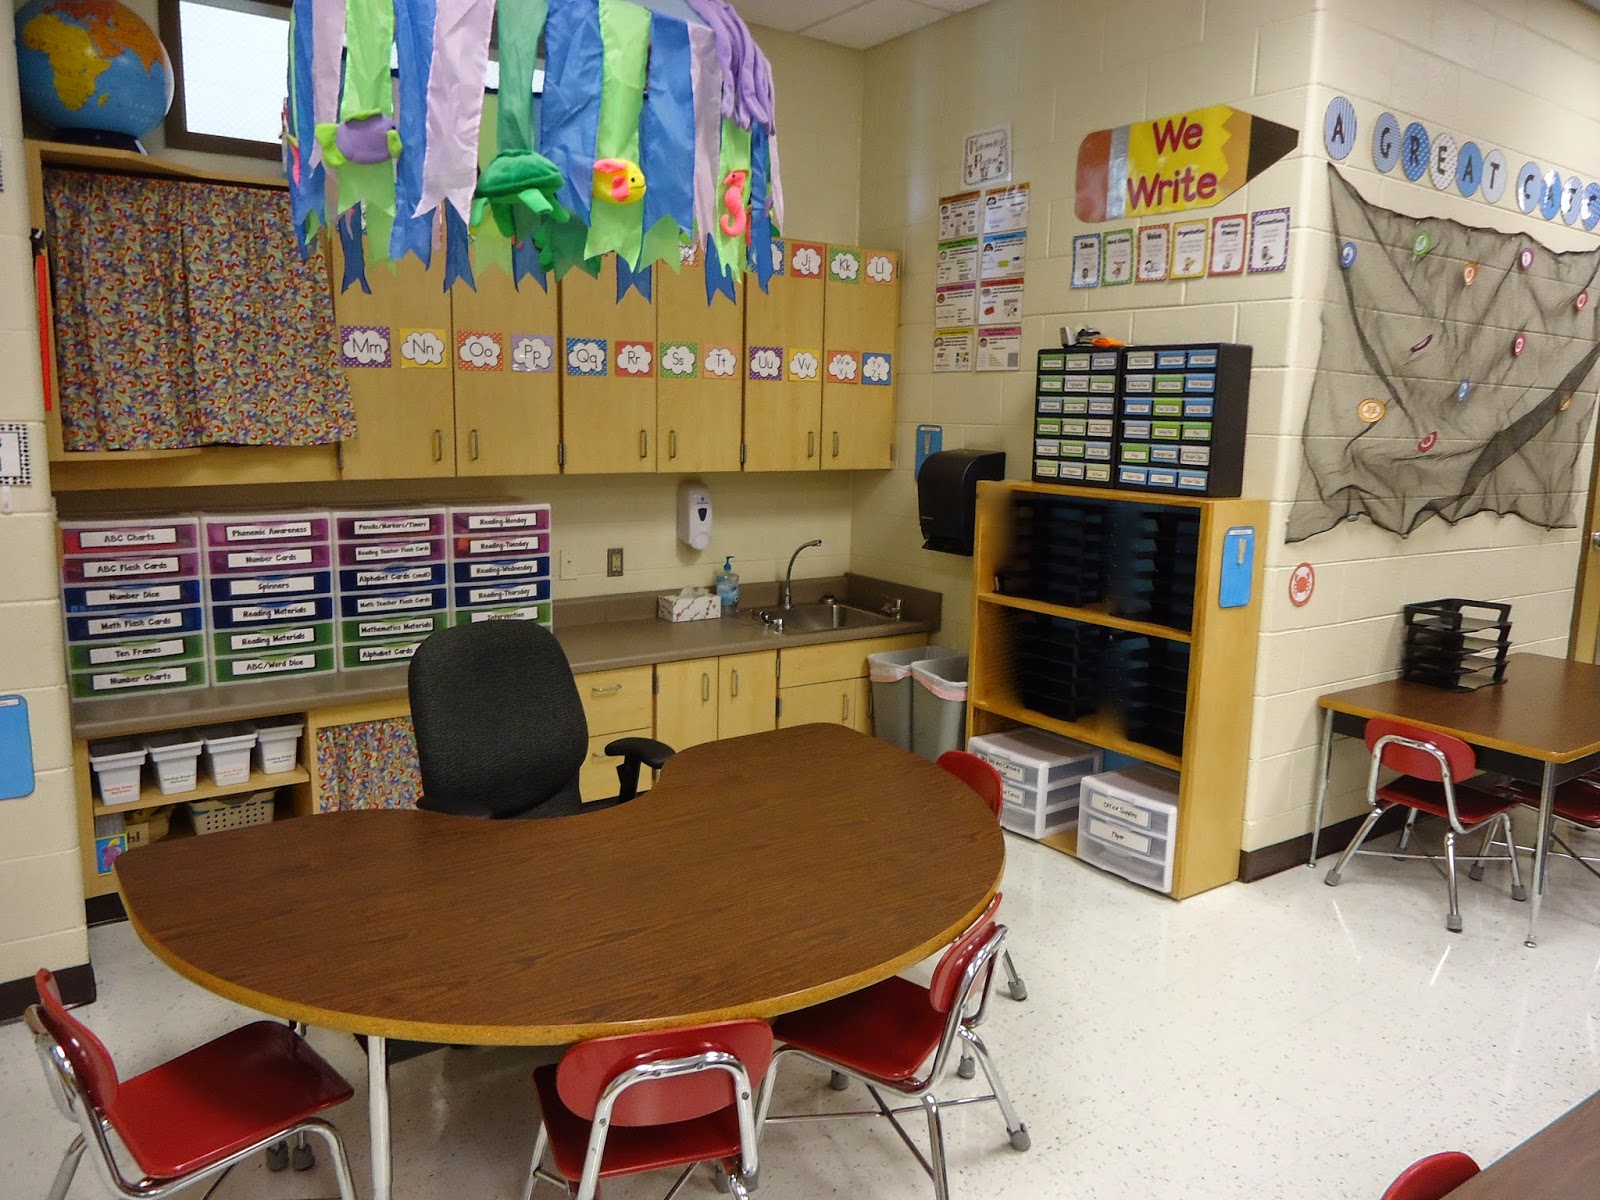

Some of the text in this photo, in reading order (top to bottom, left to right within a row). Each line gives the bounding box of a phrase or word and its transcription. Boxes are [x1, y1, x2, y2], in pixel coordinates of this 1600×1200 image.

[1153, 116, 1203, 155] We
[1331, 112, 1344, 145] A
[1380, 127, 1500, 189] GREAT
[1127, 167, 1217, 210] Write
[802, 254, 811, 271] Jj
[840, 259, 851, 271] Kk
[351, 337, 383, 354] Mm
[412, 339, 434, 355] Nn
[469, 342, 493, 358] Oo
[524, 345, 541, 364] Pp
[576, 349, 598, 367] Qq
[628, 351, 641, 363] Rr
[672, 353, 684, 366] Ss
[715, 353, 727, 367] Tt
[759, 356, 774, 369] Uu
[797, 358, 812, 370] Vv
[480, 517, 527, 527] Reading-Monday
[104, 532, 155, 543] ABC Charts
[232, 526, 307, 538] Phonemic Awareness
[480, 541, 529, 550] Reading-Tuesday
[245, 553, 296, 563] Number Cards
[358, 549, 379, 558] Reading
[380, 547, 400, 555] Teacher
[401, 546, 415, 554] Flash
[97, 562, 167, 573] ABC Flash Cards
[359, 574, 389, 583] Alphabet
[391, 572, 410, 580] Cards
[258, 581, 289, 591] Spinners
[109, 590, 160, 601] Number Dice
[478, 588, 530, 599] Reading-Thursday
[360, 600, 375, 608] Math
[399, 597, 413, 605] Flash
[243, 606, 306, 619] Reading Materials
[101, 617, 171, 630] Math Flash Cards
[361, 621, 432, 633] Mathematics Materials
[242, 632, 305, 646] Reading Materials
[116, 646, 161, 658] Ten Frames
[362, 647, 413, 660] Alphabet Cards
[110, 672, 171, 685] Number Charts
[1103, 801, 1118, 811] Office
